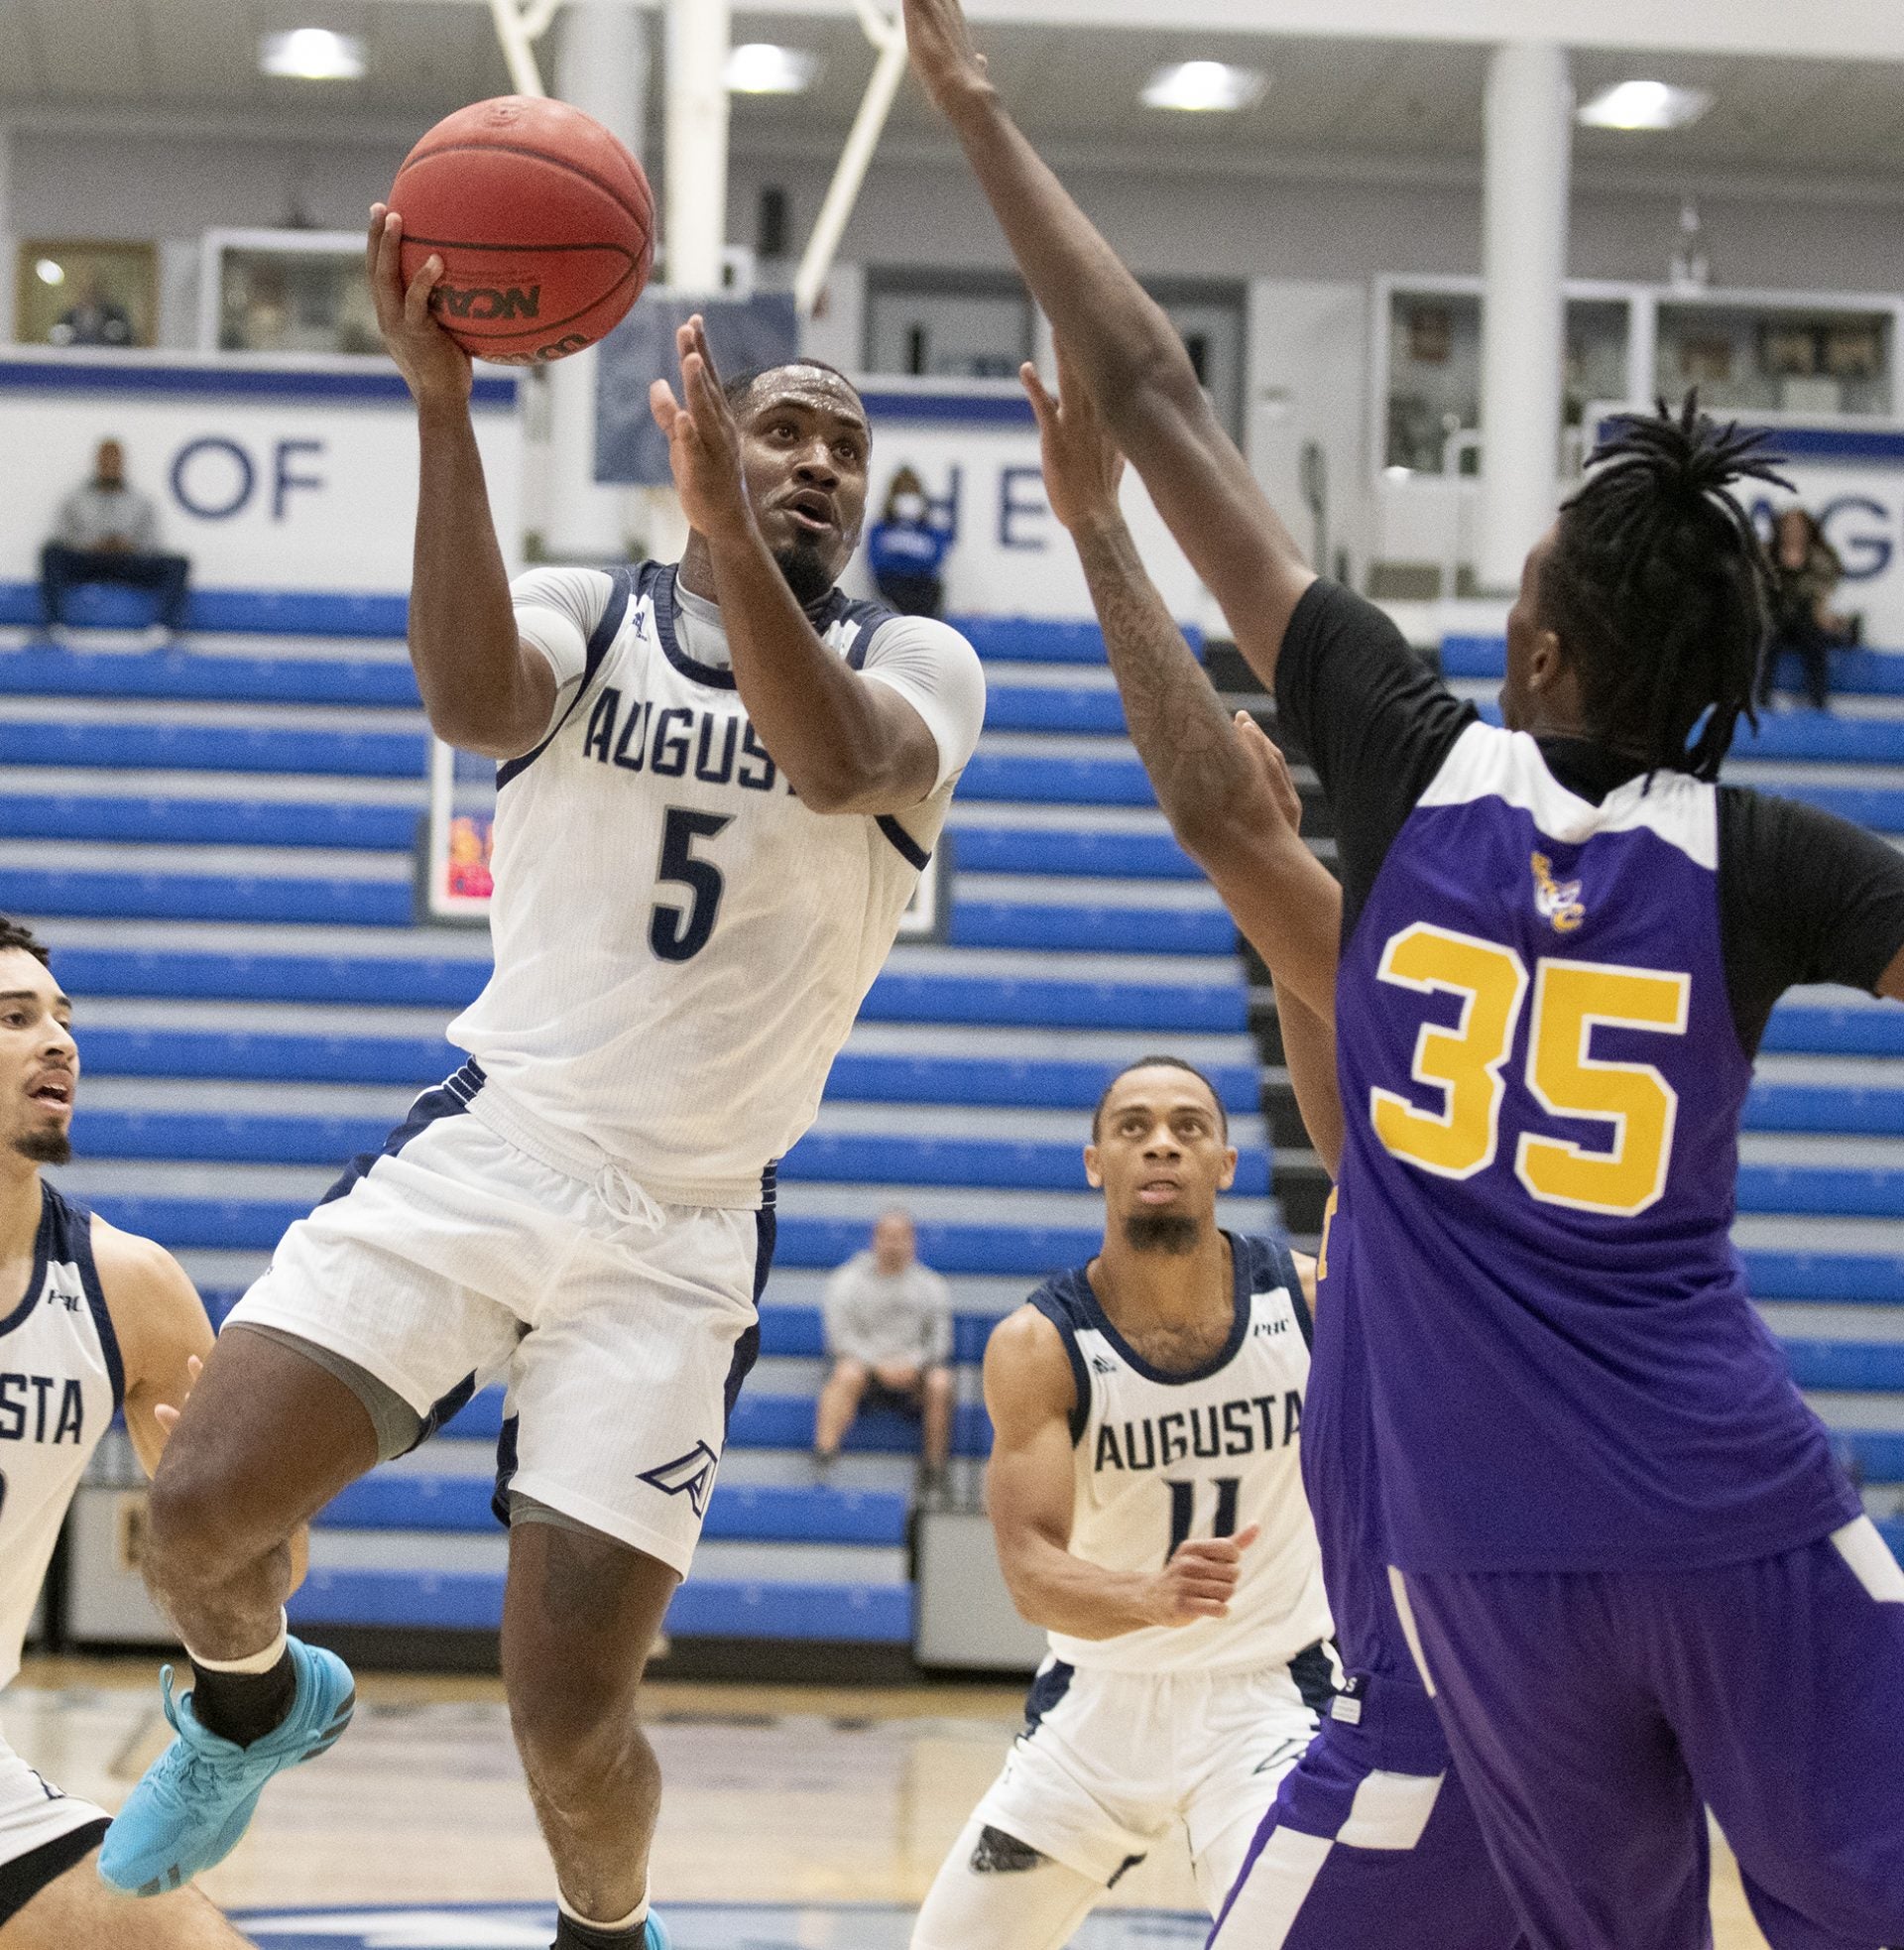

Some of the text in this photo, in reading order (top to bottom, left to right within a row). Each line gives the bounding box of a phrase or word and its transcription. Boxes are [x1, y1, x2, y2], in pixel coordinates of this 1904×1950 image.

[170, 436, 325, 521] OF
[582, 686, 796, 795] AUGUS
[647, 804, 738, 965] 5
[1370, 920, 1692, 1218] 35
[1161, 1477, 1242, 1566] 11
